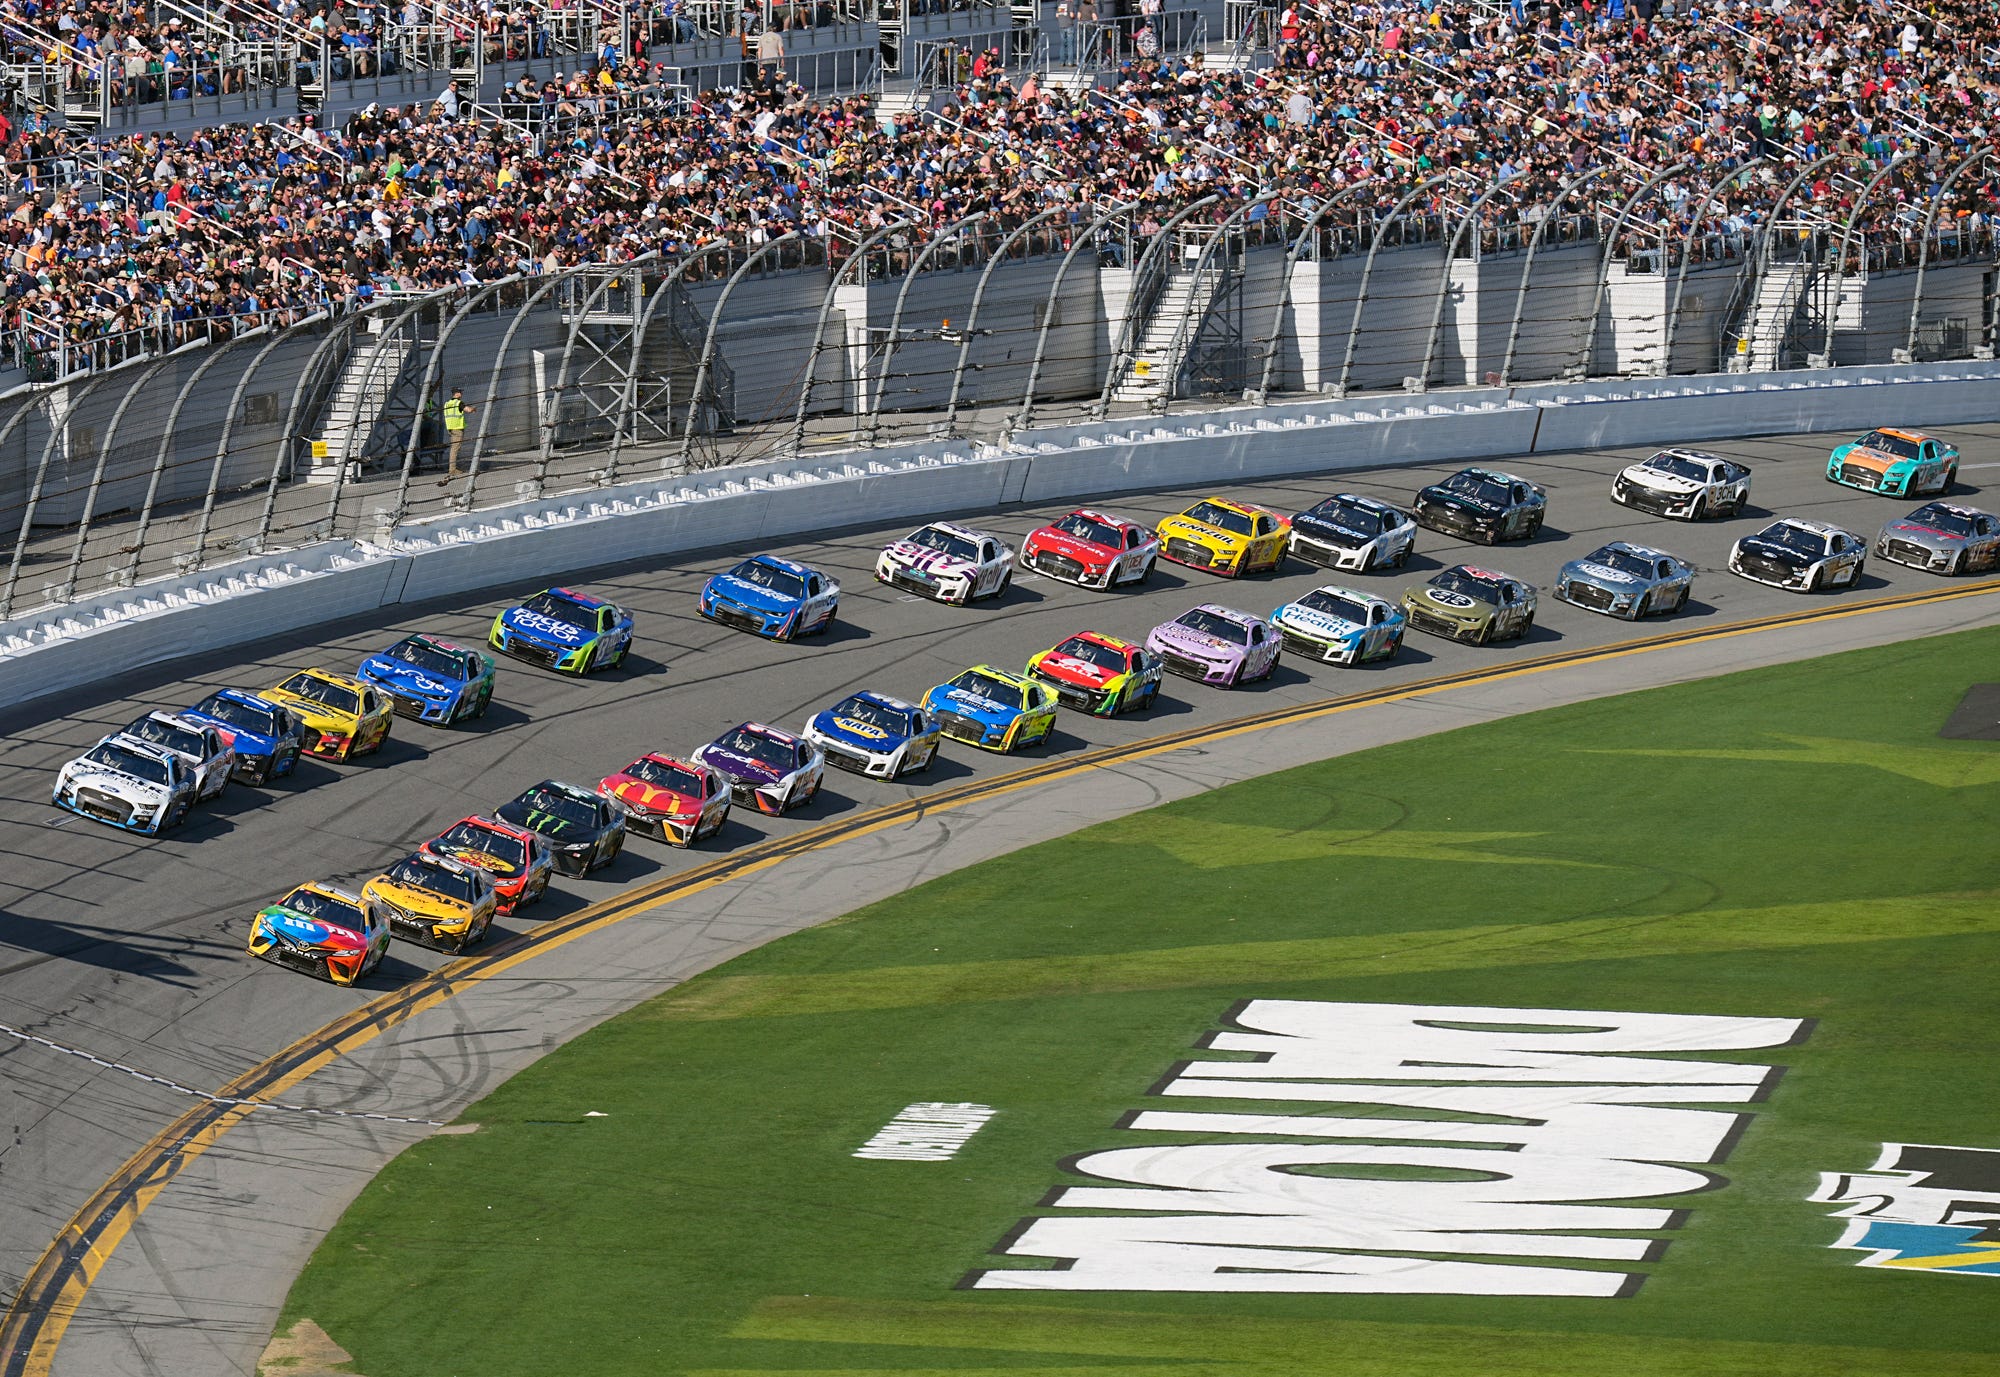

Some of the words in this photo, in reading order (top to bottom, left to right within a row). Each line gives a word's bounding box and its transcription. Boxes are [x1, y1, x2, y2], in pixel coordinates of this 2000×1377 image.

[1169, 521, 1235, 545] PENNZOIL
[513, 615, 580, 642] factor
[1284, 611, 1346, 636] Health
[1286, 606, 1350, 629] Advent
[394, 669, 453, 694] Kroger
[946, 695, 991, 713] PLATINUM
[841, 719, 880, 735] NAPA
[707, 746, 780, 775] FedEx
[746, 764, 779, 782] Express
[72, 765, 158, 799] Generators
[965, 998, 1808, 1295] DAYTONA
